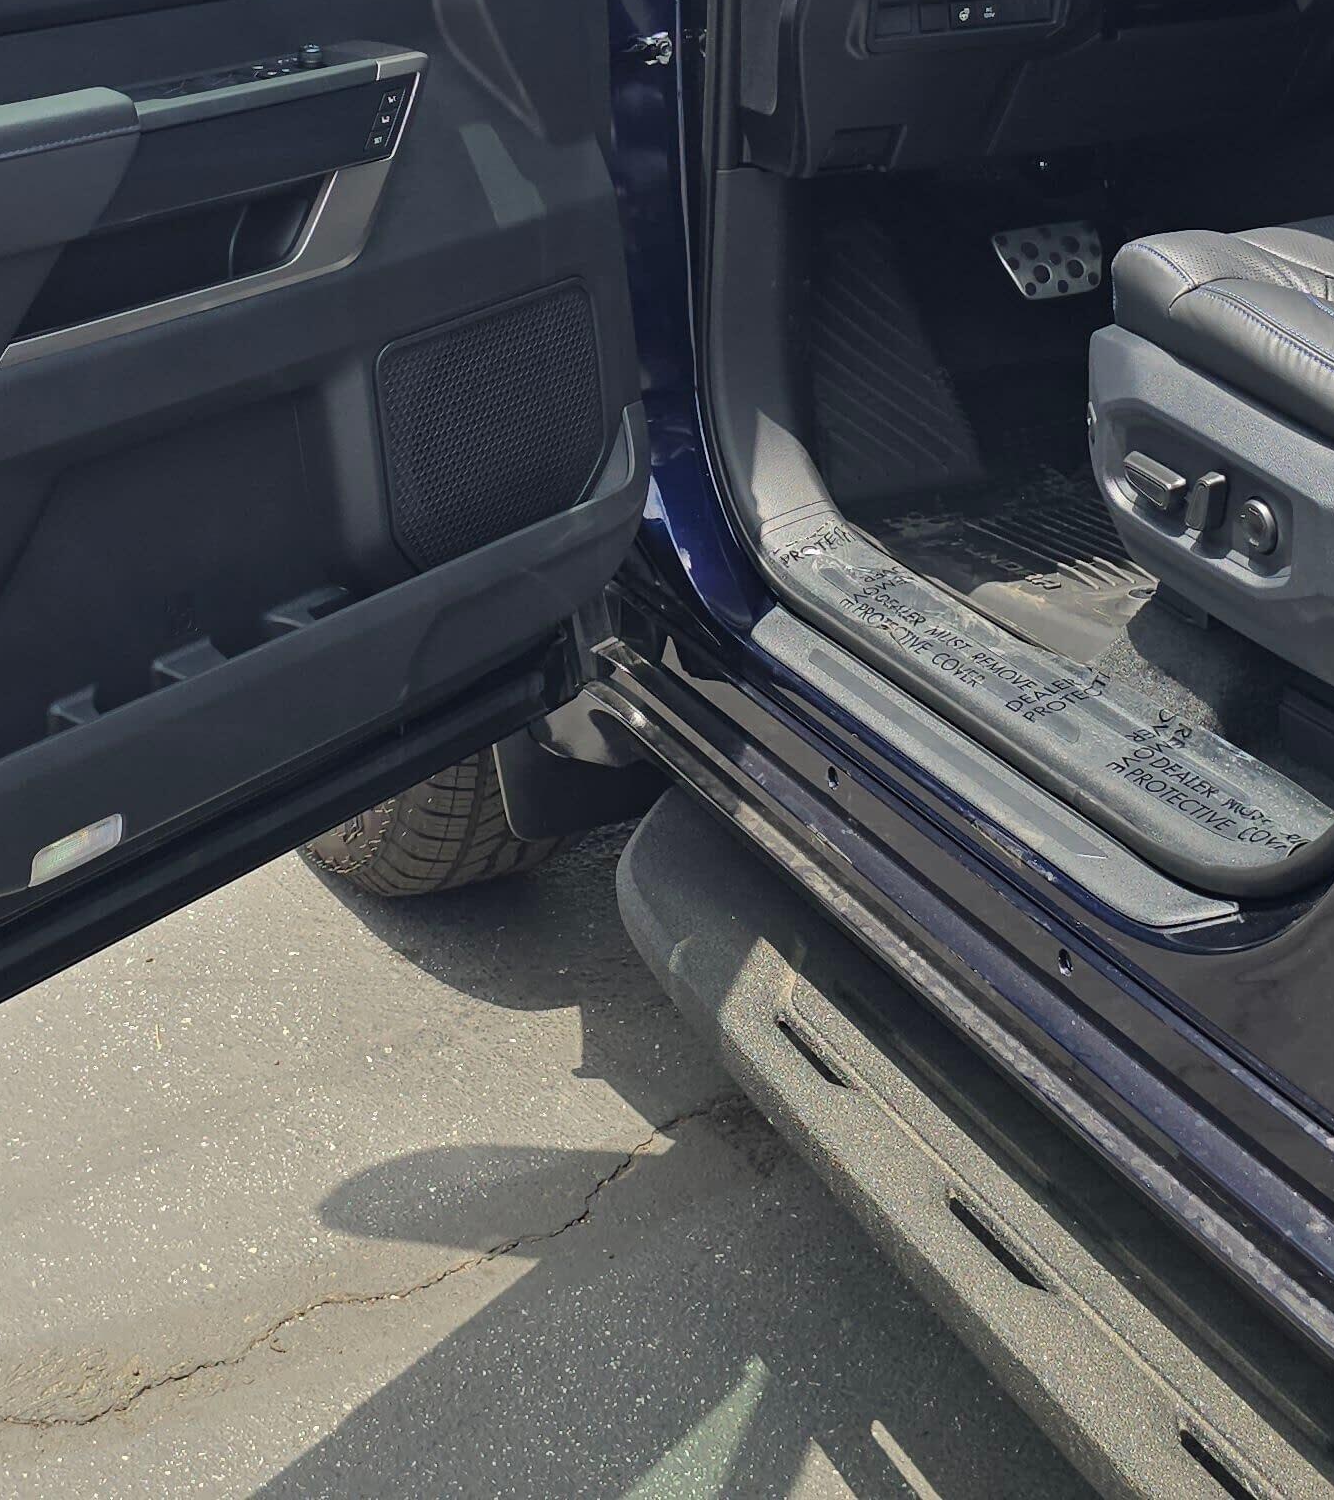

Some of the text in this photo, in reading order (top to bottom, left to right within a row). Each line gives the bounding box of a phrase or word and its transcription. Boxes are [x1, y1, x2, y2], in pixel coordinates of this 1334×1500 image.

[854, 603, 987, 688] PROTECTIVE COVER
[924, 625, 973, 651] MUST
[971, 652, 1037, 692] REMOVE
[1124, 768, 1236, 831] PROTECTIVE
[1149, 756, 1219, 798] DEALER
